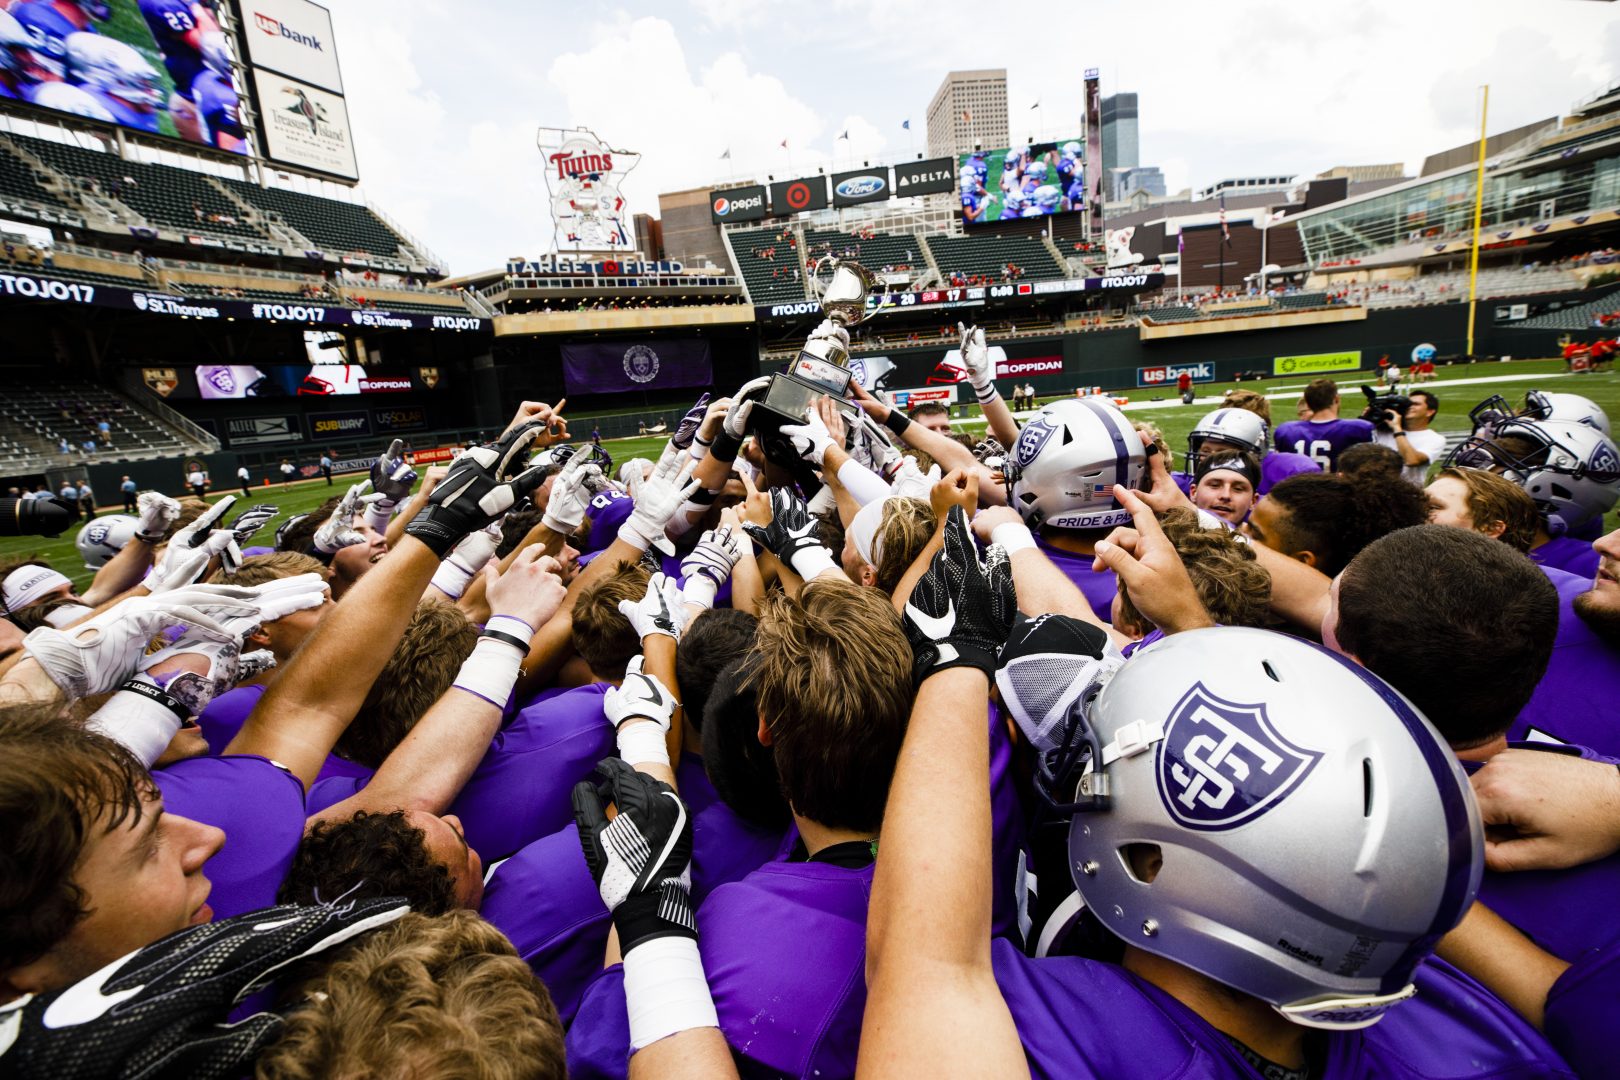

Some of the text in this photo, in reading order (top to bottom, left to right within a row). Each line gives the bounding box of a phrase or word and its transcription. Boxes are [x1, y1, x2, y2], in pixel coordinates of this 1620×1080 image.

[163, 11, 194, 31] 23
[254, 12, 323, 52] usbank
[318, 123, 344, 143] Island
[550, 150, 613, 181] Twins
[911, 170, 951, 184] DELTA
[845, 180, 876, 196] Ford
[730, 195, 762, 213] pepsi
[506, 260, 684, 275] TARGET FIELD
[0, 274, 94, 303] TOJO17
[1101, 275, 1148, 289] #TOJO17
[946, 289, 961, 302] 17
[990, 285, 1014, 297] 0:00
[900, 293, 915, 306] 20
[252, 303, 325, 321] #TOJO17
[771, 302, 820, 317] #TOJO17
[432, 315, 481, 330] #TOJO17
[1009, 360, 1063, 374] OPPIDAN
[1299, 357, 1353, 369] CenturyLink
[1143, 363, 1211, 383] usbank
[369, 380, 412, 389] OPPIDAN
[229, 420, 256, 433] ALTEC
[315, 417, 365, 432] SUBWAY
[1056, 516, 1102, 527] PRIDE
[1102, 515, 1113, 525] &
[131, 682, 161, 697] LEGACY
[1277, 938, 1324, 967] Riddell
